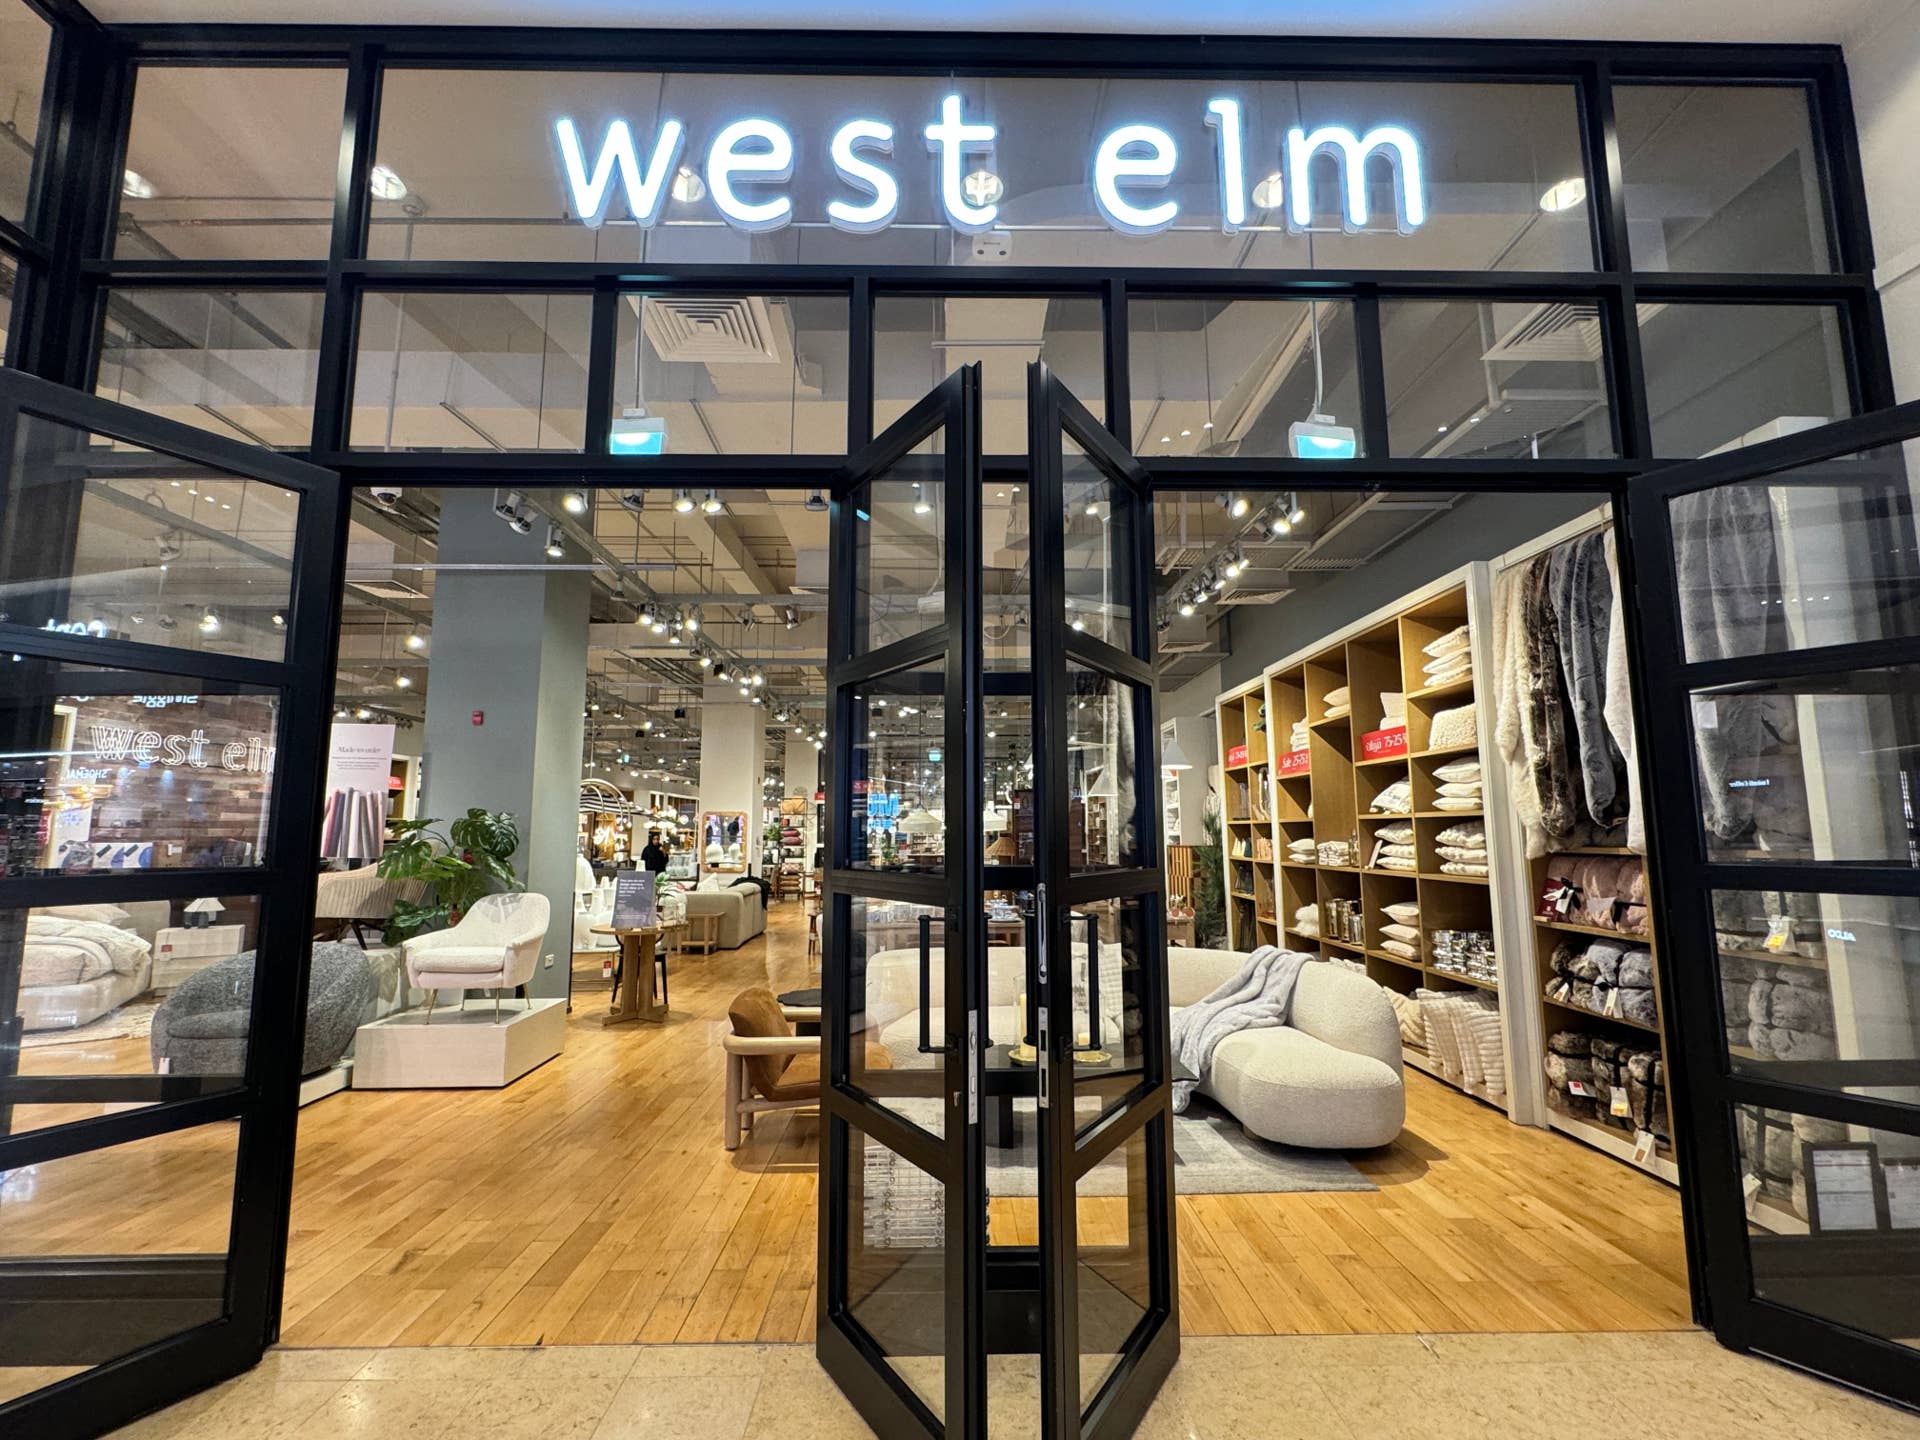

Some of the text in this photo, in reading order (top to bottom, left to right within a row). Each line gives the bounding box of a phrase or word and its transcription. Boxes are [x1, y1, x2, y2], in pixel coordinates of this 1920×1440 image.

[554, 93, 1430, 236] west elm
[90, 725, 210, 769] west
